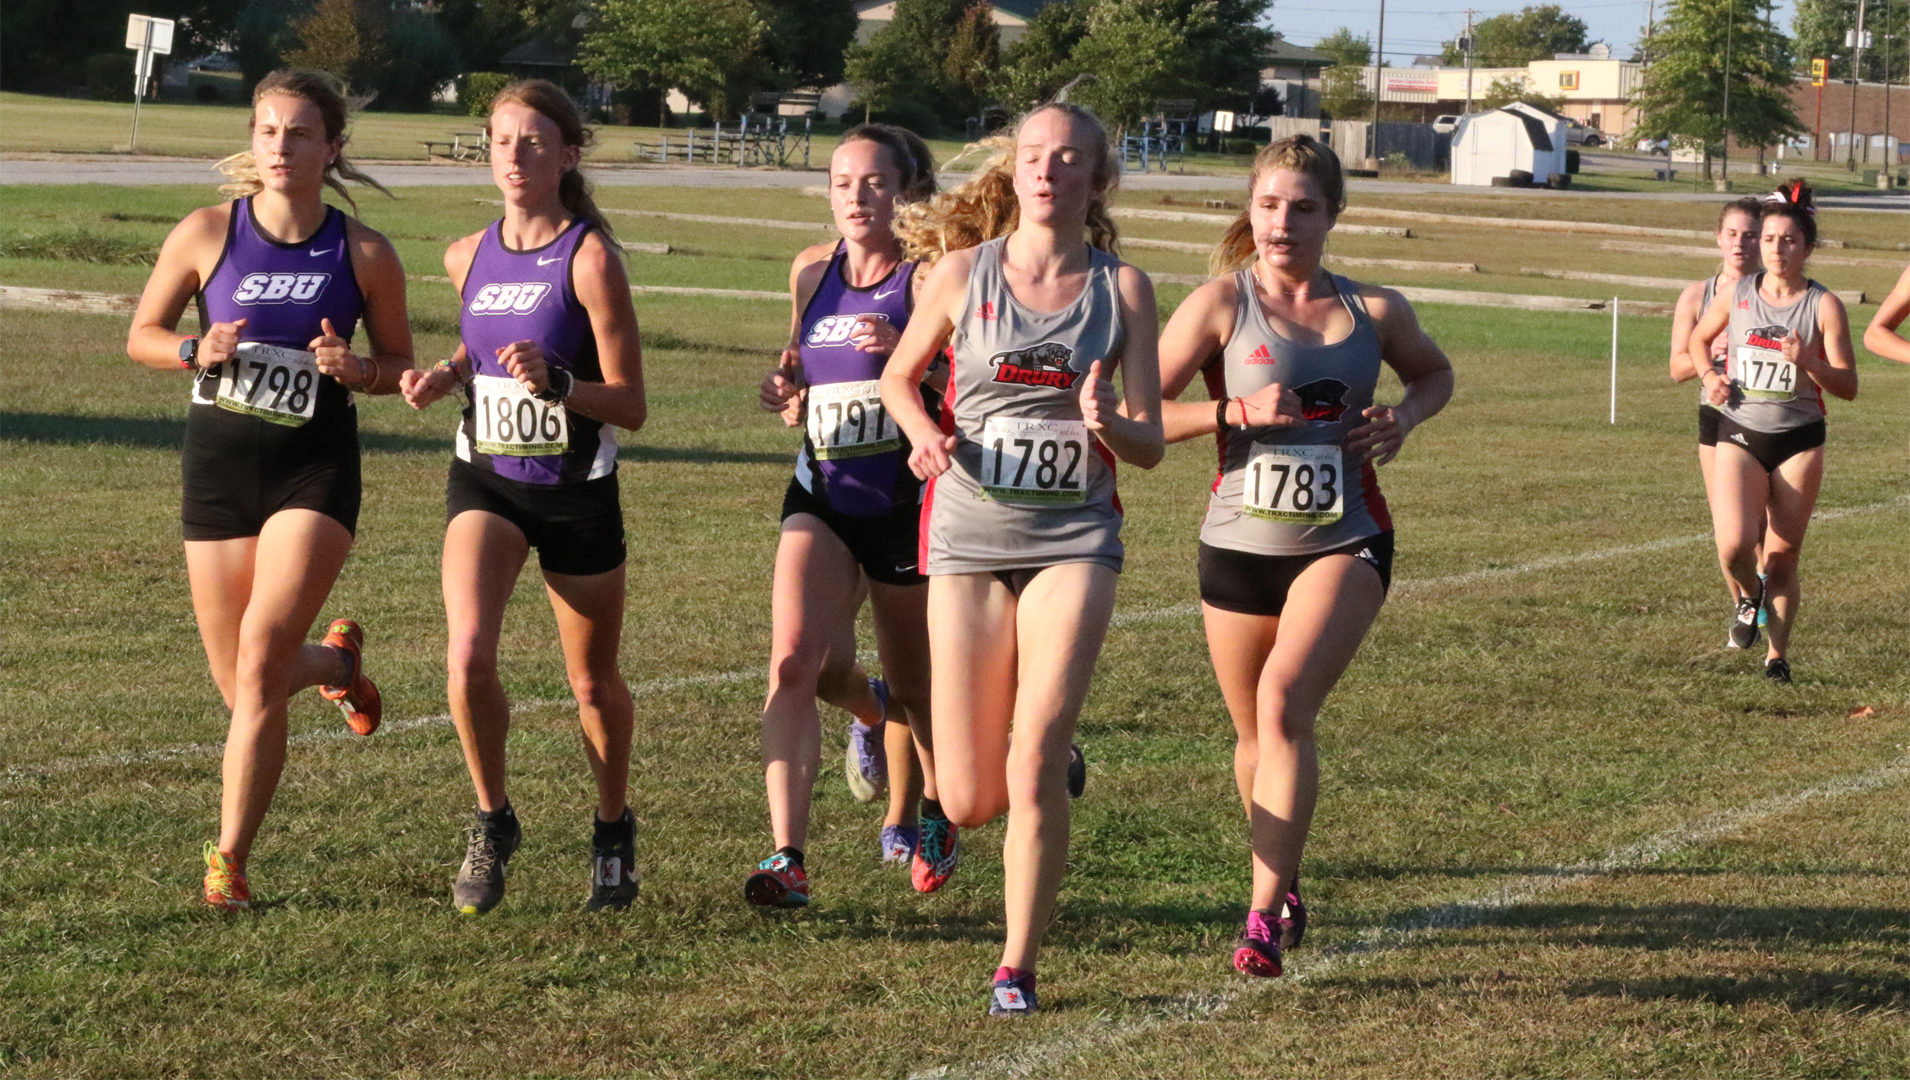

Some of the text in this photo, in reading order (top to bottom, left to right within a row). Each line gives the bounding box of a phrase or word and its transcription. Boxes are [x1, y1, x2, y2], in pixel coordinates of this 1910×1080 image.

[235, 274, 327, 302] SBU
[471, 284, 547, 312] SBU
[253, 346, 292, 360] TRXC
[1747, 334, 1782, 350] DRUR
[1244, 356, 1275, 365] adidas
[229, 357, 313, 414] 1798
[1742, 359, 1792, 391] 1774
[219, 396, 308, 422] WWW.TRXCTIMING.COM
[482, 395, 561, 443] 1806
[815, 397, 887, 447] 1797
[1013, 422, 1058, 432] TRXC
[993, 437, 1083, 490] 1782
[1272, 448, 1313, 457] TRXC
[1252, 461, 1337, 512] 1783
[1245, 505, 1338, 519] WWW.TRXCTIMING.COM
